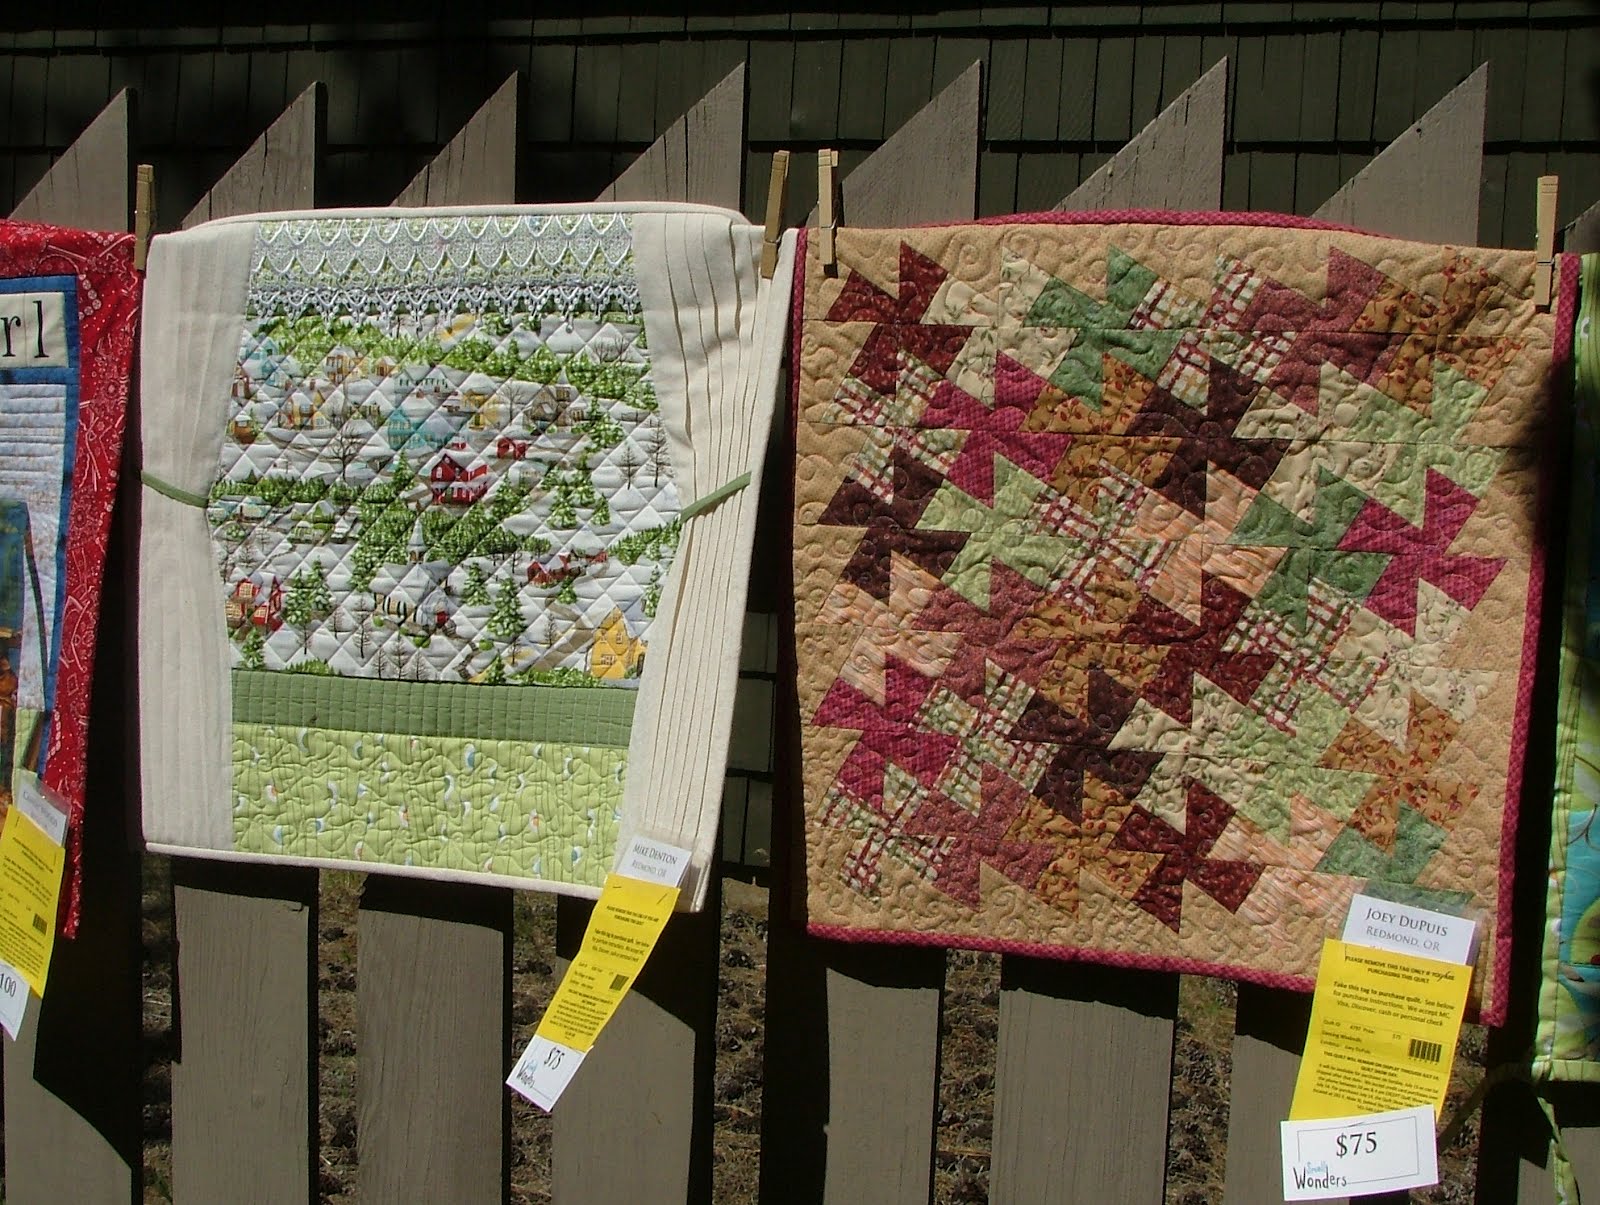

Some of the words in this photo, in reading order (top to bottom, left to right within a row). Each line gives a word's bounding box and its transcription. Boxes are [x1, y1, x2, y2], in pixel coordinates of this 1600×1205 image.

[649, 848, 678, 865] DENTON
[1365, 907, 1396, 924] JOEY
[1423, 939, 1441, 952] OR
[1364, 959, 1386, 969] REMOVE
[1401, 973, 1413, 981] THIS
[1414, 976, 1430, 984] QUILT
[1333, 981, 1347, 989] Take
[1348, 983, 1359, 991] this
[1360, 986, 1370, 994] tag
[1379, 990, 1405, 1000] purchase
[1436, 1001, 1455, 1010] below
[1342, 992, 1368, 1003] purchase
[1418, 1008, 1438, 1017] accept
[1400, 1013, 1426, 1023] personal
[1336, 1131, 1378, 1158] $75
[1293, 1166, 1347, 1190] Wonders
